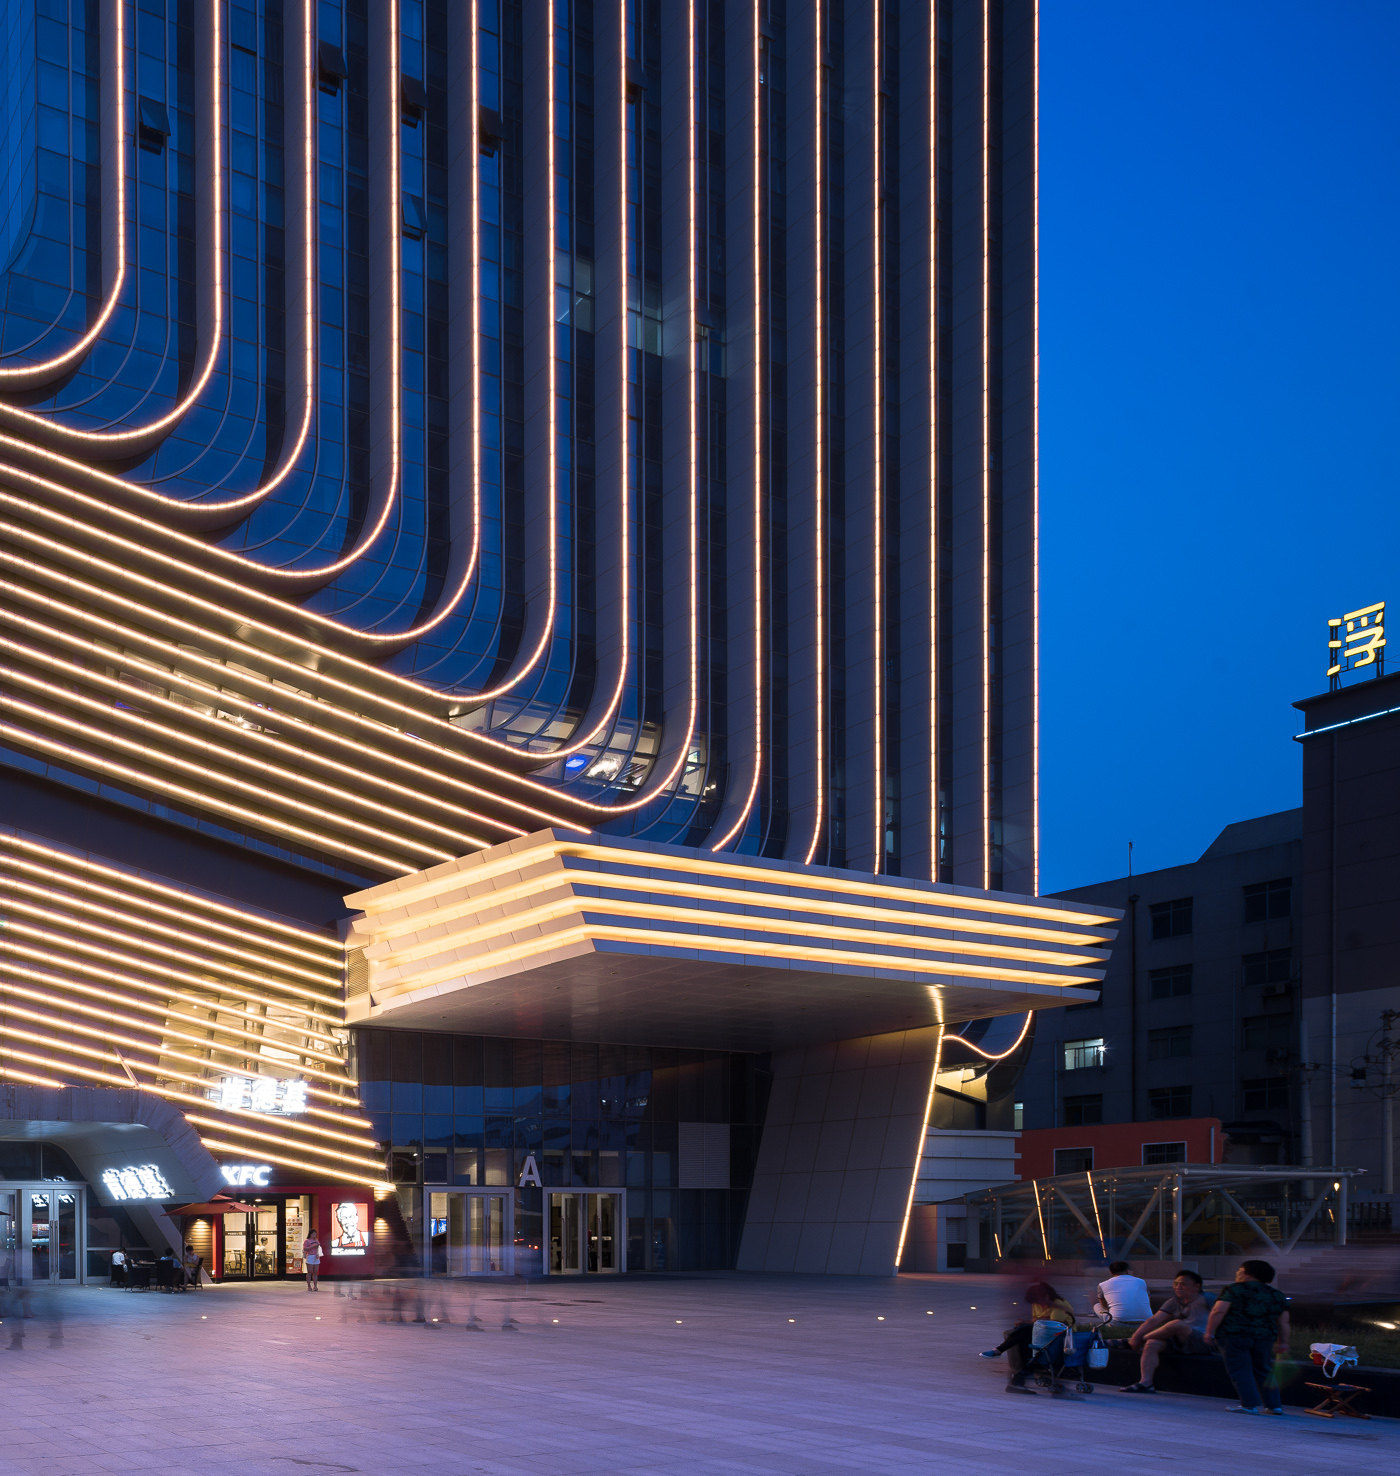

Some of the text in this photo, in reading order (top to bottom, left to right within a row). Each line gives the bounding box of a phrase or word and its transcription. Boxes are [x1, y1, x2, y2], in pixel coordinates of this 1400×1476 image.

[1327, 601, 1386, 676] 浮
[221, 1166, 272, 1186] KFC
[519, 1155, 542, 1187] A
